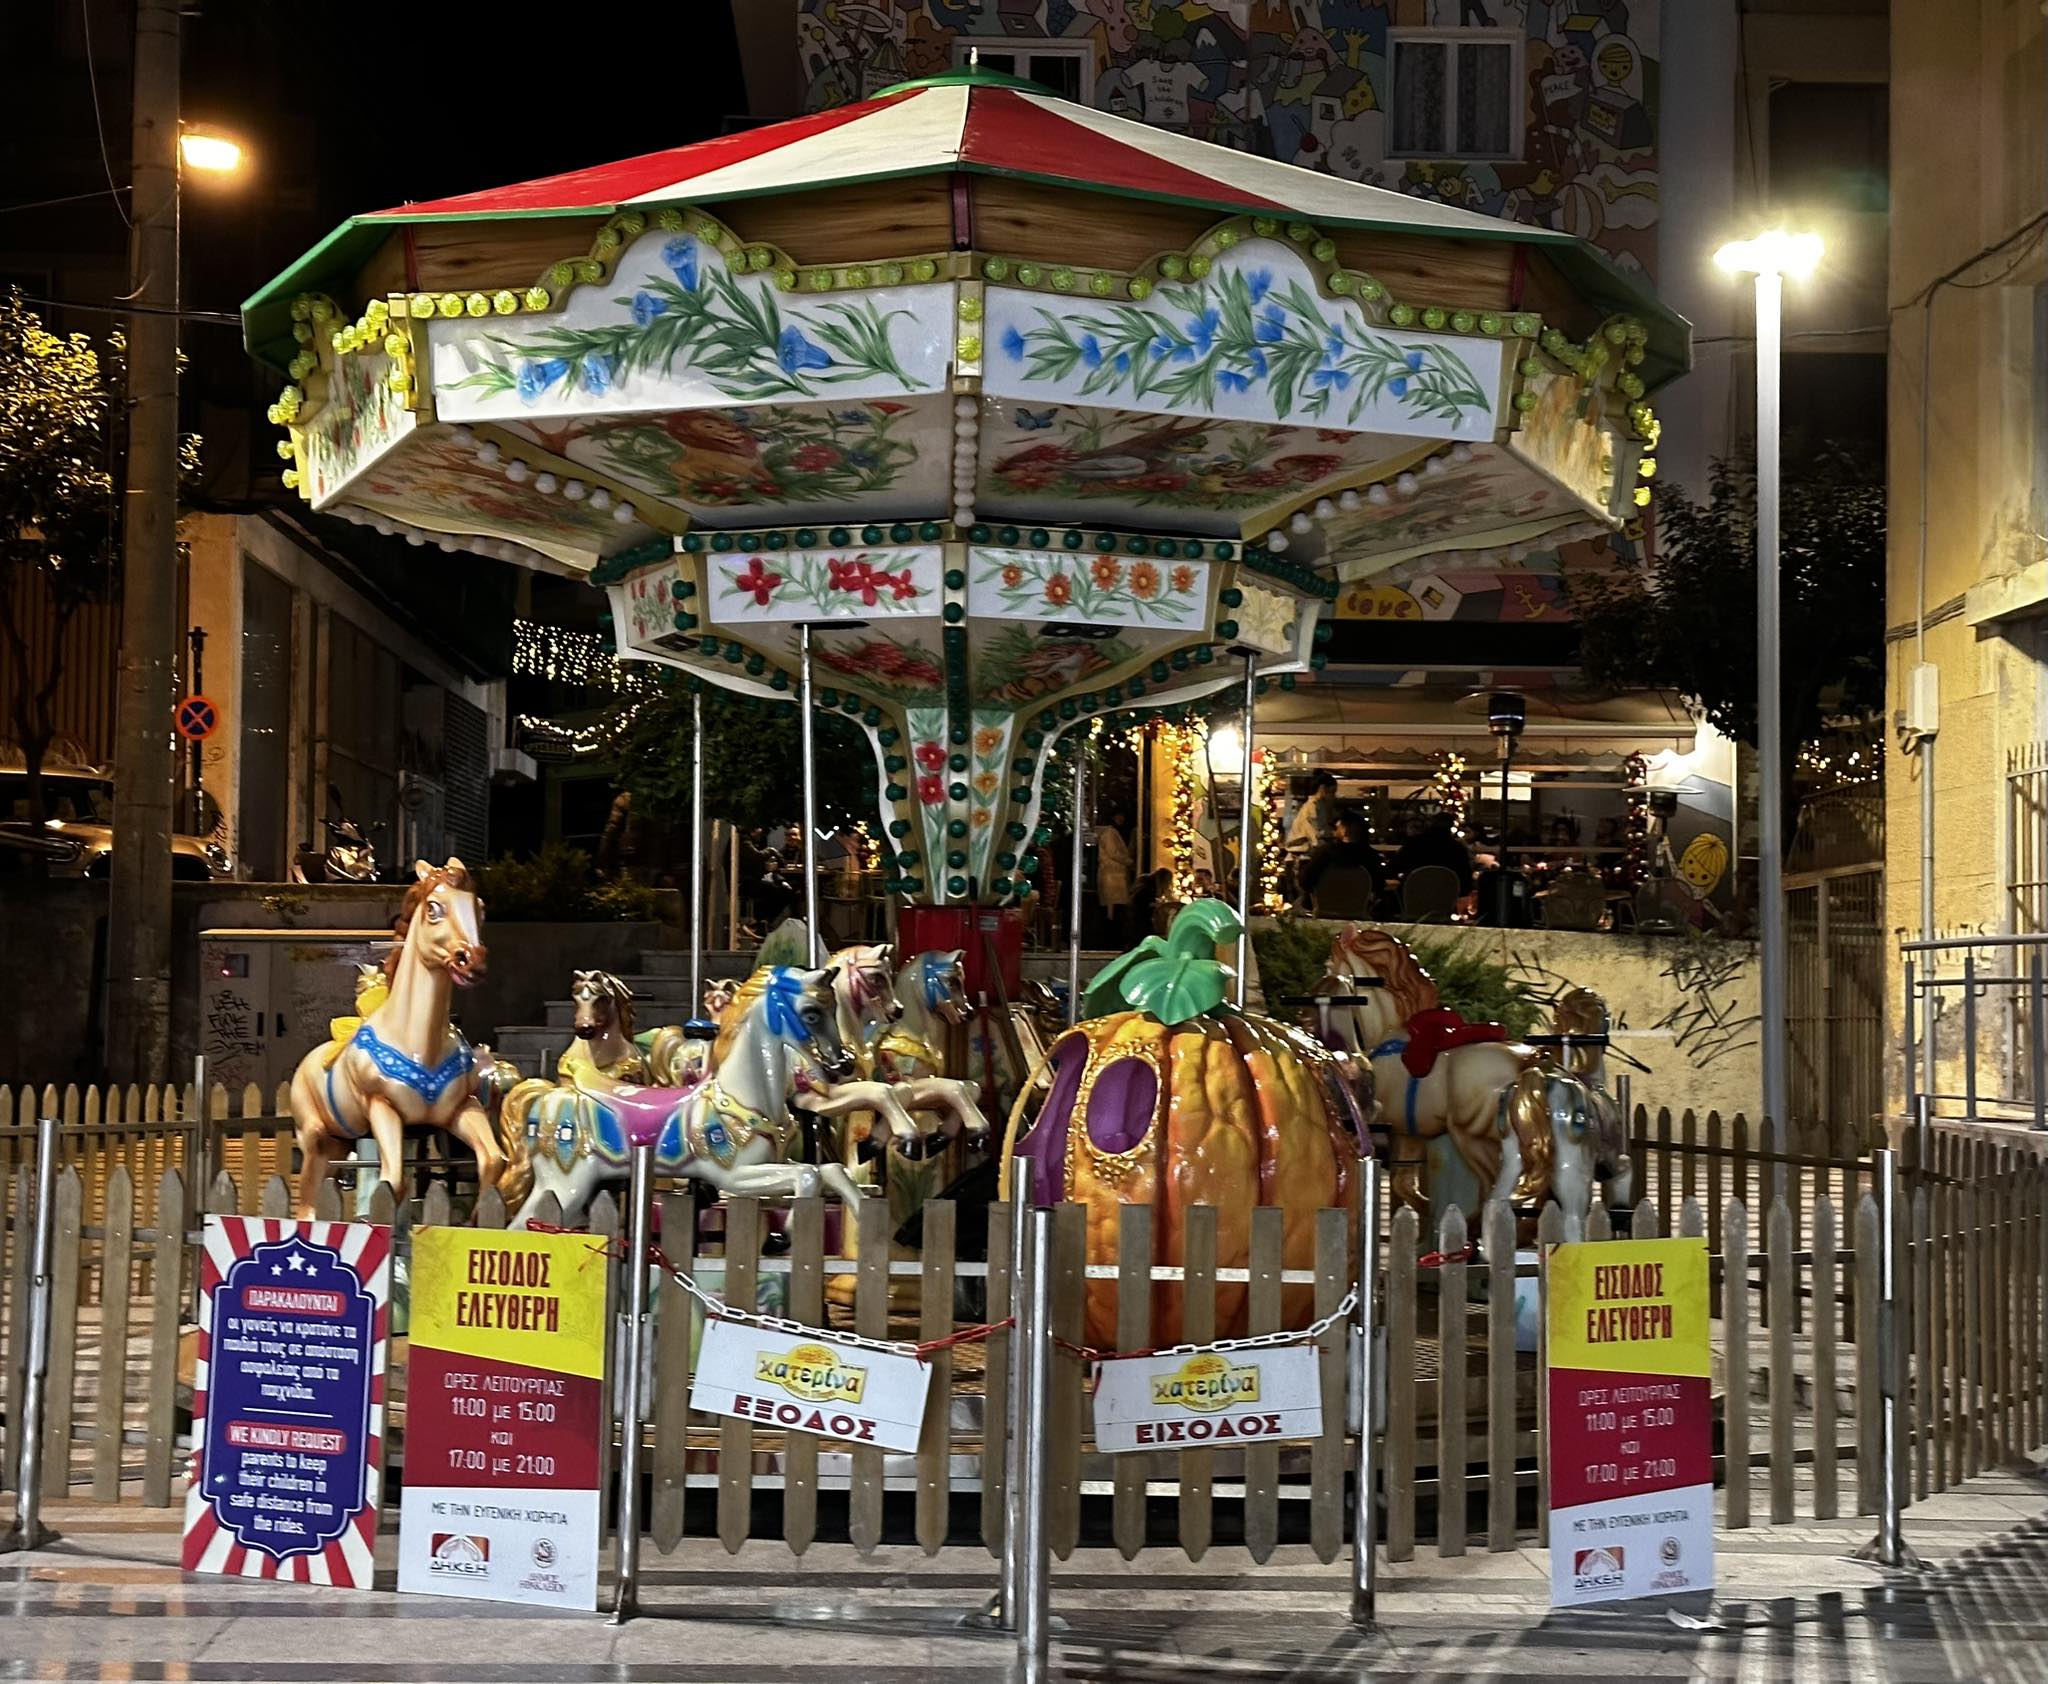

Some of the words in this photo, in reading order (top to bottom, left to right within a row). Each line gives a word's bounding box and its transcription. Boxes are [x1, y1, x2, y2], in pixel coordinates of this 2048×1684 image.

[468, 1249, 552, 1288] ΕΙΣΟΔΟΣ
[1595, 1263, 1664, 1300] ΕΙΣΟΔΟΣ
[249, 1290, 338, 1312] ΠΑΡΑΚΑΛΟΥΝΤΑΙ
[456, 1291, 560, 1332] ΕΛΕΥΘΕΡΗ
[1587, 1305, 1673, 1343] ΕΛΕΥΘΕΡΗ
[444, 1373, 479, 1391] ΩΡΕΣ
[482, 1376, 565, 1397] ΛΕΙΤΟΥΡΓΙΑΣ
[1579, 1389, 1608, 1406] ΩΡΕΣ
[451, 1397, 486, 1417] 11:00
[517, 1402, 556, 1422] 15:00
[733, 1394, 877, 1441] ΕΞΟΔΟΣ
[229, 1426, 249, 1442] WE
[251, 1427, 290, 1446] KINDLY
[291, 1431, 343, 1450] REQUEST
[1136, 1415, 1282, 1444] ΕΙΣΟΔΟΣ
[241, 1452, 284, 1468] parents
[285, 1454, 297, 1469] to
[299, 1454, 327, 1475] keep
[448, 1450, 486, 1470] 17:00
[516, 1455, 555, 1476] 21:00
[1585, 1464, 1617, 1484] 17:00
[1644, 1459, 1676, 1478] 21:00
[238, 1471, 266, 1487] their
[267, 1473, 313, 1492] children
[315, 1477, 327, 1493] in
[229, 1492, 255, 1508] safe
[256, 1493, 304, 1513] distance
[305, 1498, 333, 1516] from
[253, 1514, 272, 1531] the
